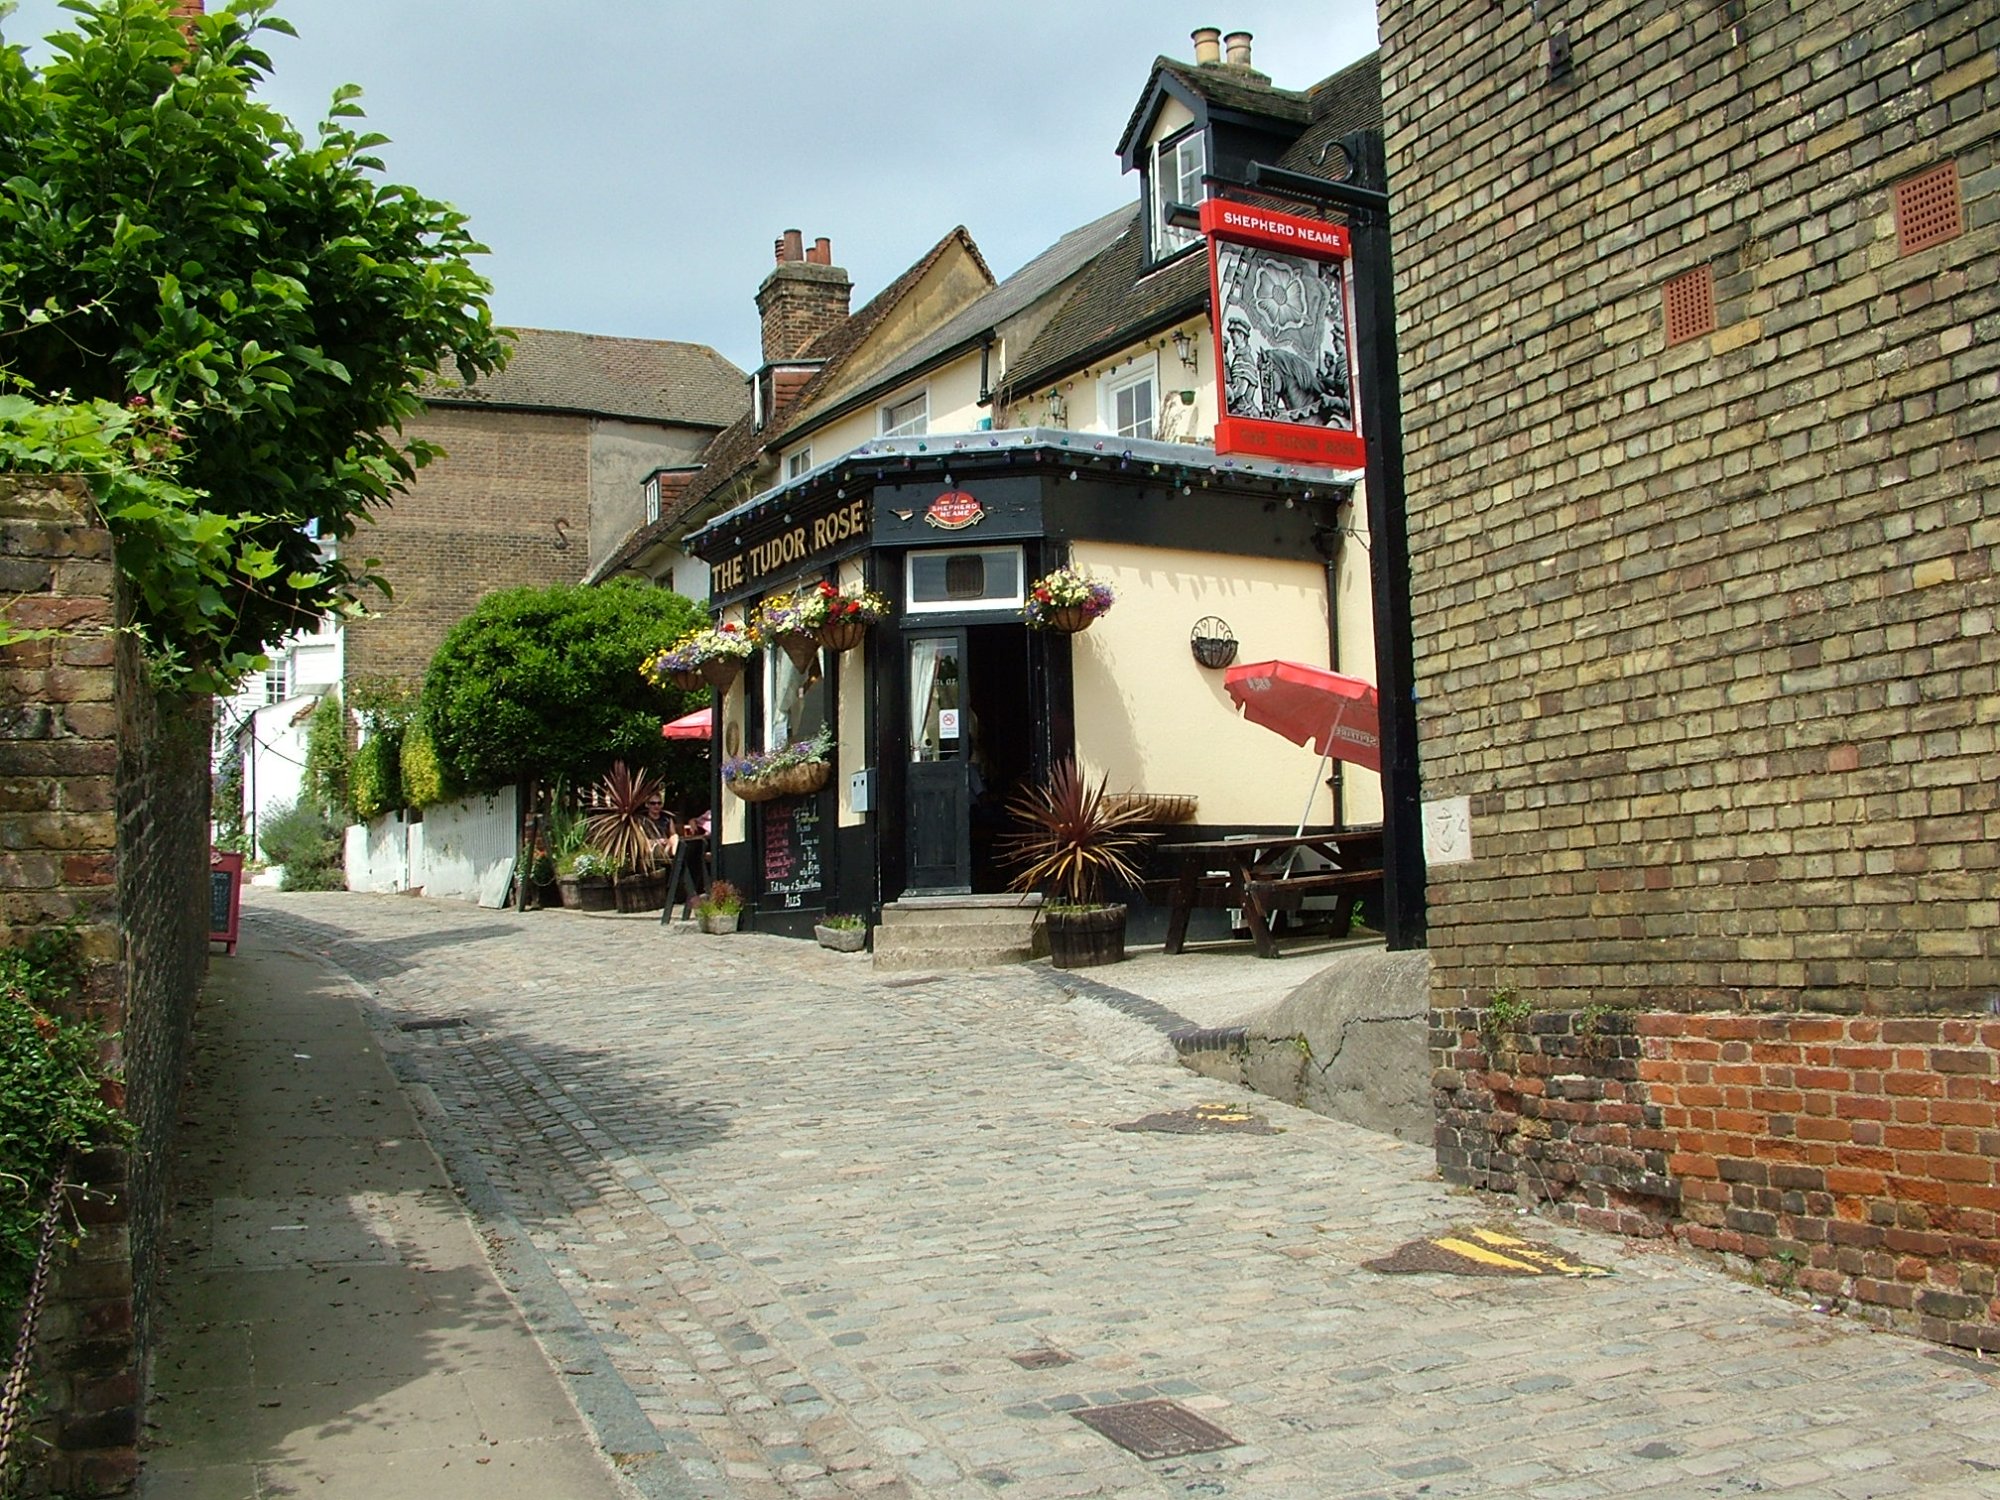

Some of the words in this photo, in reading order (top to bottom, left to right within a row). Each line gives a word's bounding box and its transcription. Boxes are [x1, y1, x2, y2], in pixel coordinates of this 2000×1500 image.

[1223, 212, 1295, 237] SHEPHERD
[1297, 227, 1341, 247] NEAME
[931, 503, 978, 512] SHEPHERD
[711, 553, 744, 593] THE
[749, 527, 806, 576] TUDOR
[814, 500, 864, 549] ROSE
